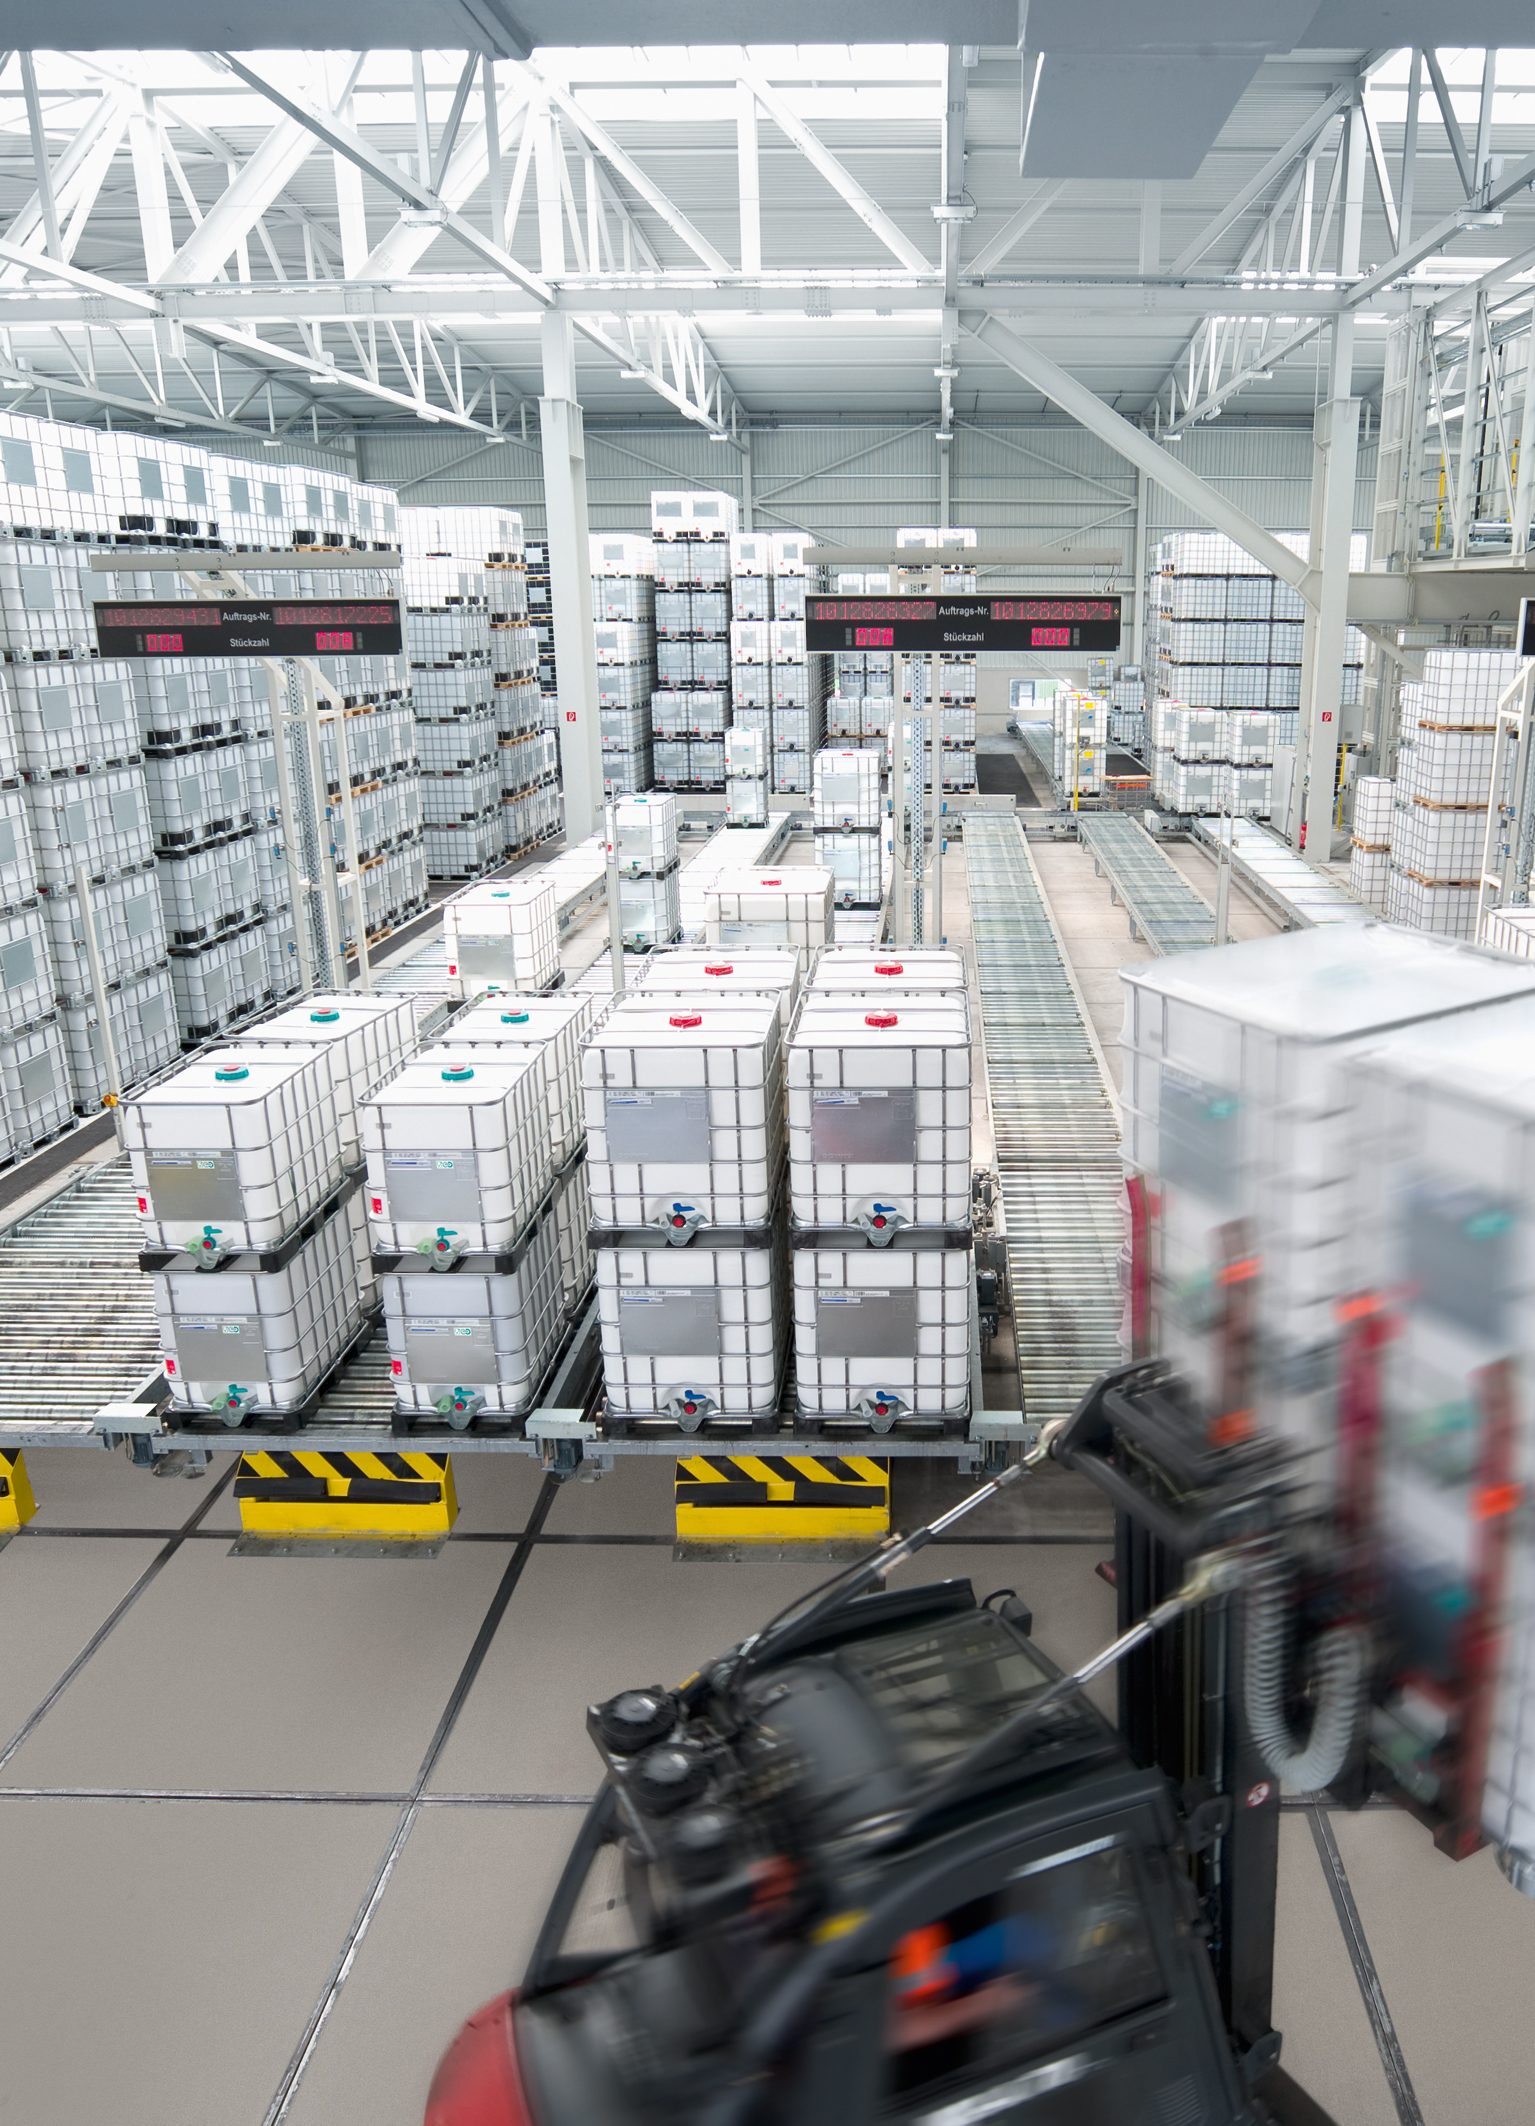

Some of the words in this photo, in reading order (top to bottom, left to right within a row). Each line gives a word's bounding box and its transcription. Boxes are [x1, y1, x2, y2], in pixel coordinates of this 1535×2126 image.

[938, 606, 989, 617] Auftrags-Nr.
[222, 611, 272, 623] Auftrags-Nr.
[230, 637, 270, 647] Stückzahl
[943, 632, 985, 642] Stückzahl
